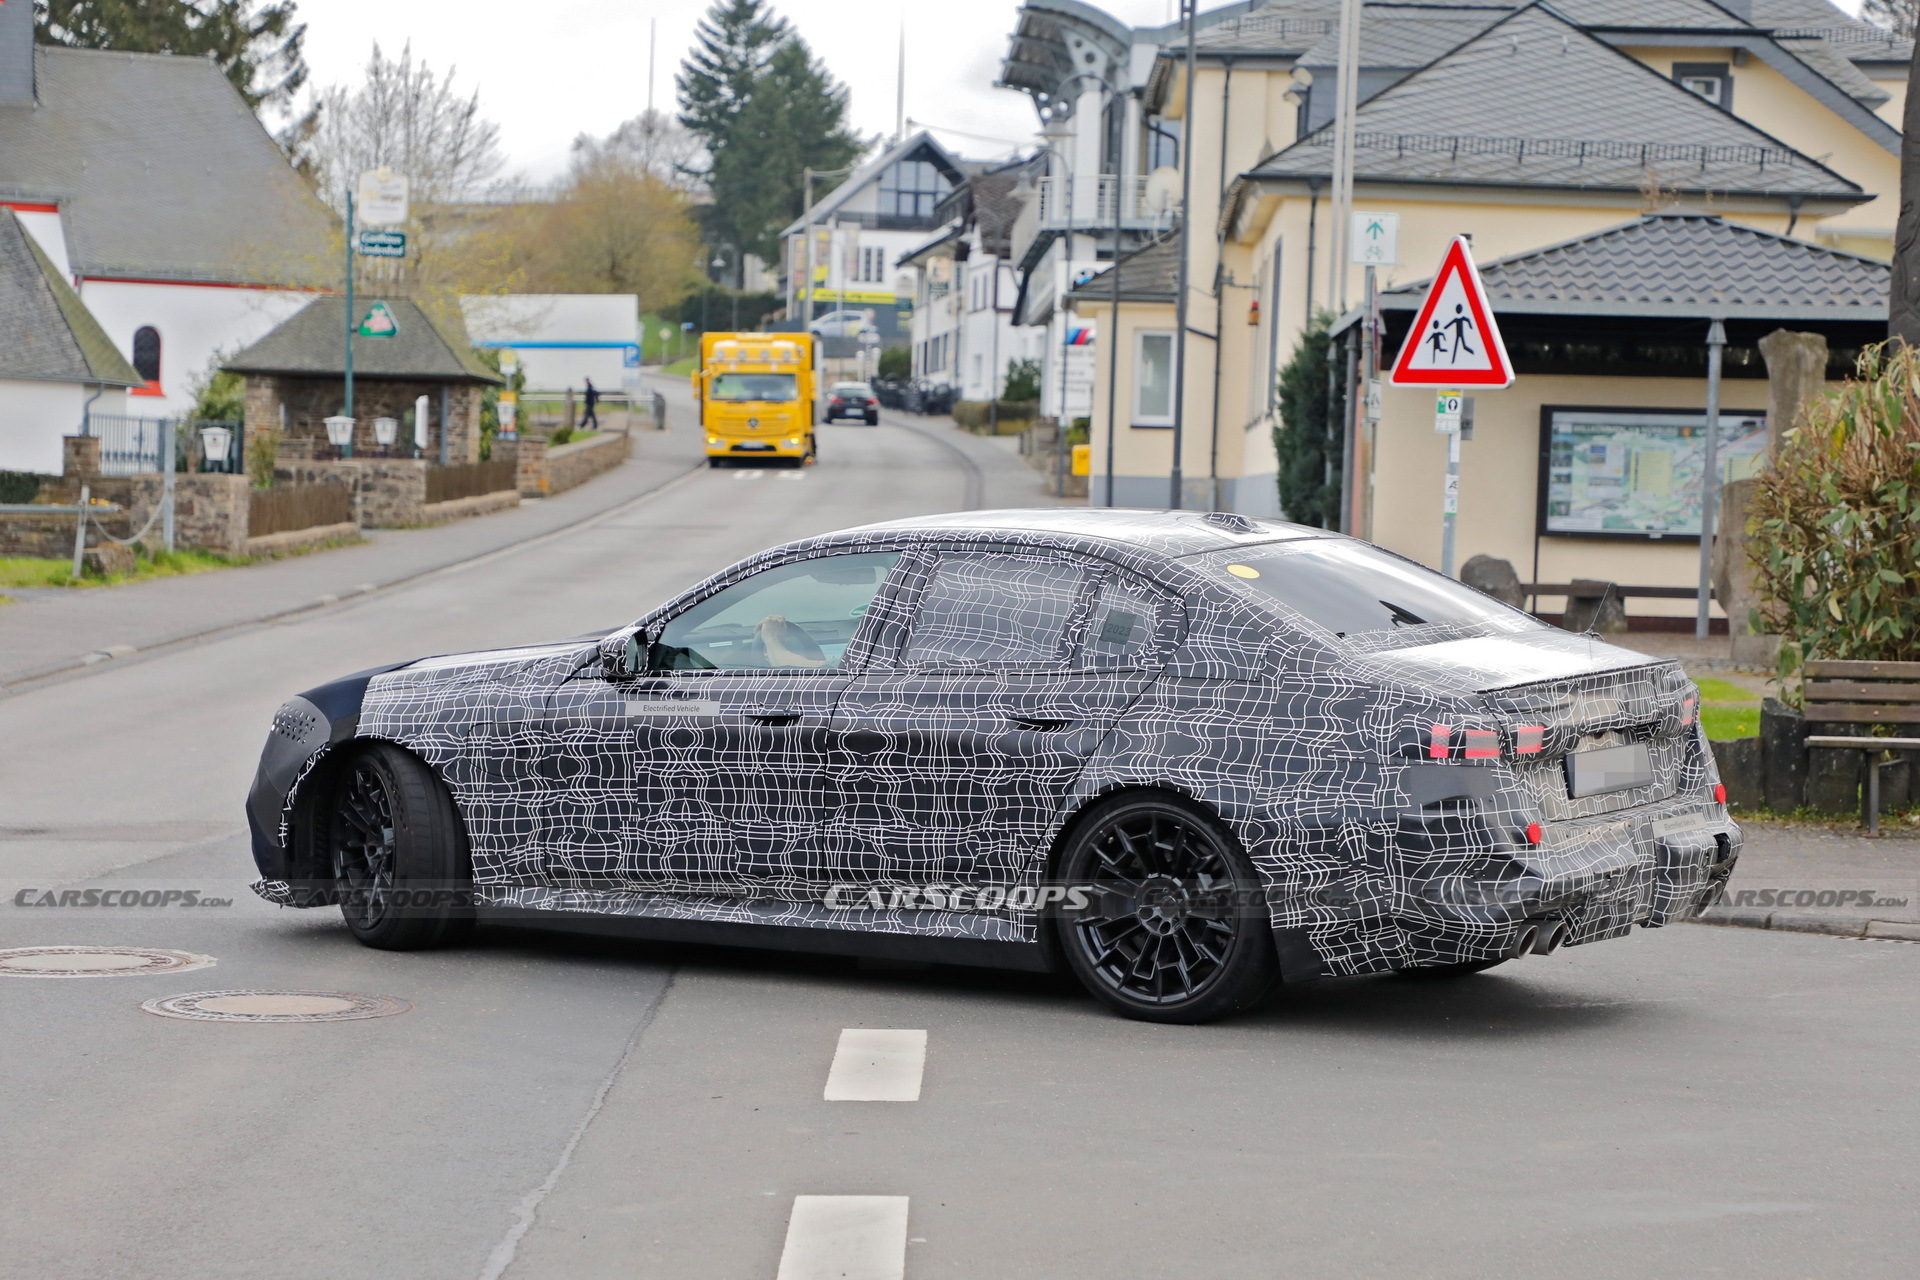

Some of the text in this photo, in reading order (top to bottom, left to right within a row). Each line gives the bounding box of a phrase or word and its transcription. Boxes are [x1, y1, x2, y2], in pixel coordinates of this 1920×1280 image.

[1107, 623, 1130, 636] 2023
[643, 704, 700, 712] Electrified Vehicle
